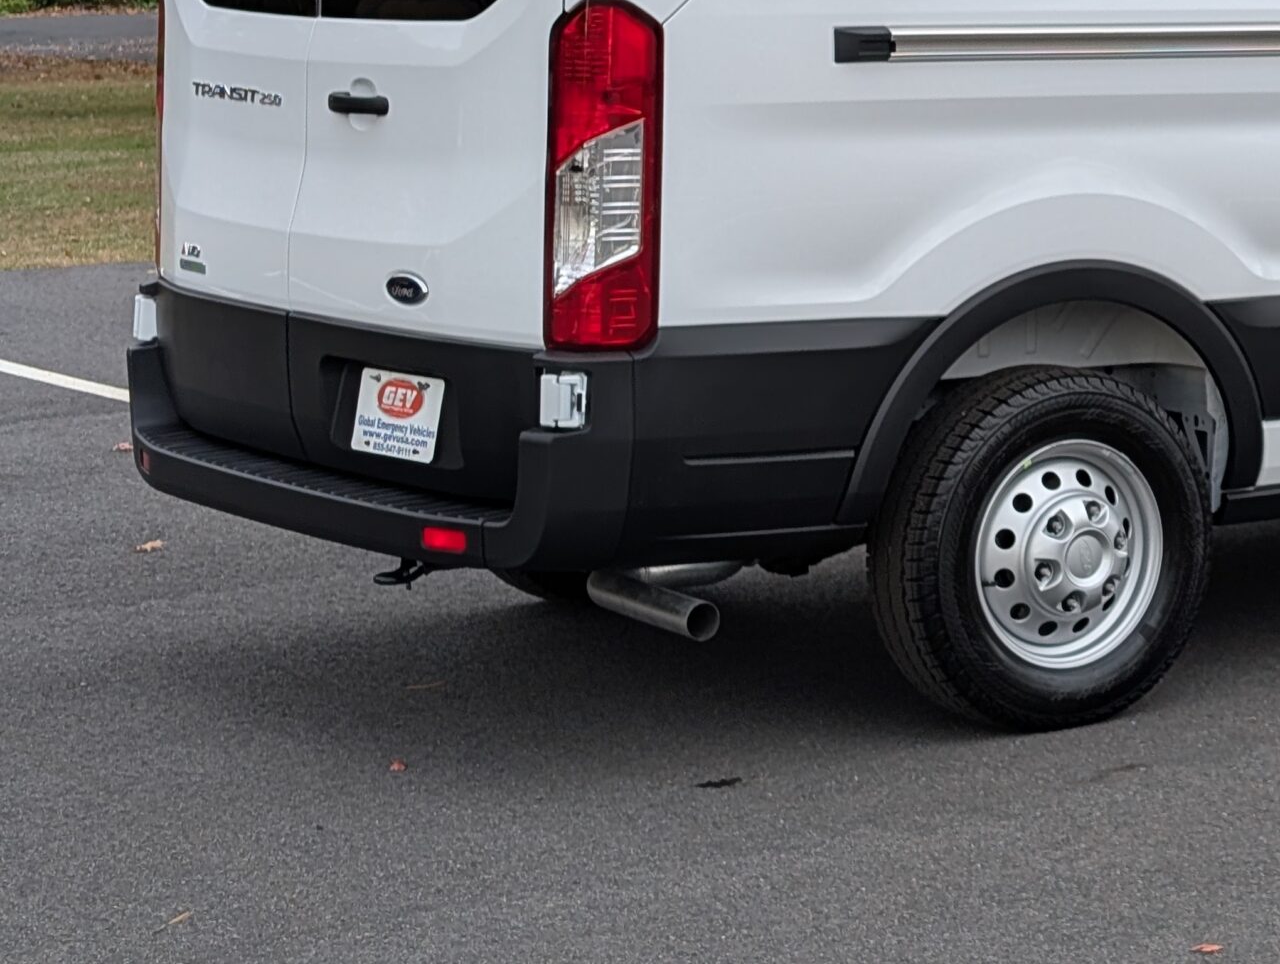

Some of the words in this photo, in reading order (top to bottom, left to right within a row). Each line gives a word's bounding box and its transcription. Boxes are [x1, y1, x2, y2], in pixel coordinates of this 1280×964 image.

[192, 81, 260, 104] TRANSIT
[259, 92, 283, 107] 250
[382, 386, 418, 409] GEV
[358, 415, 376, 427] Global
[376, 419, 408, 435] Emergency
[409, 424, 435, 439] Vehicles
[362, 429, 428, 448] www.gevusa.com
